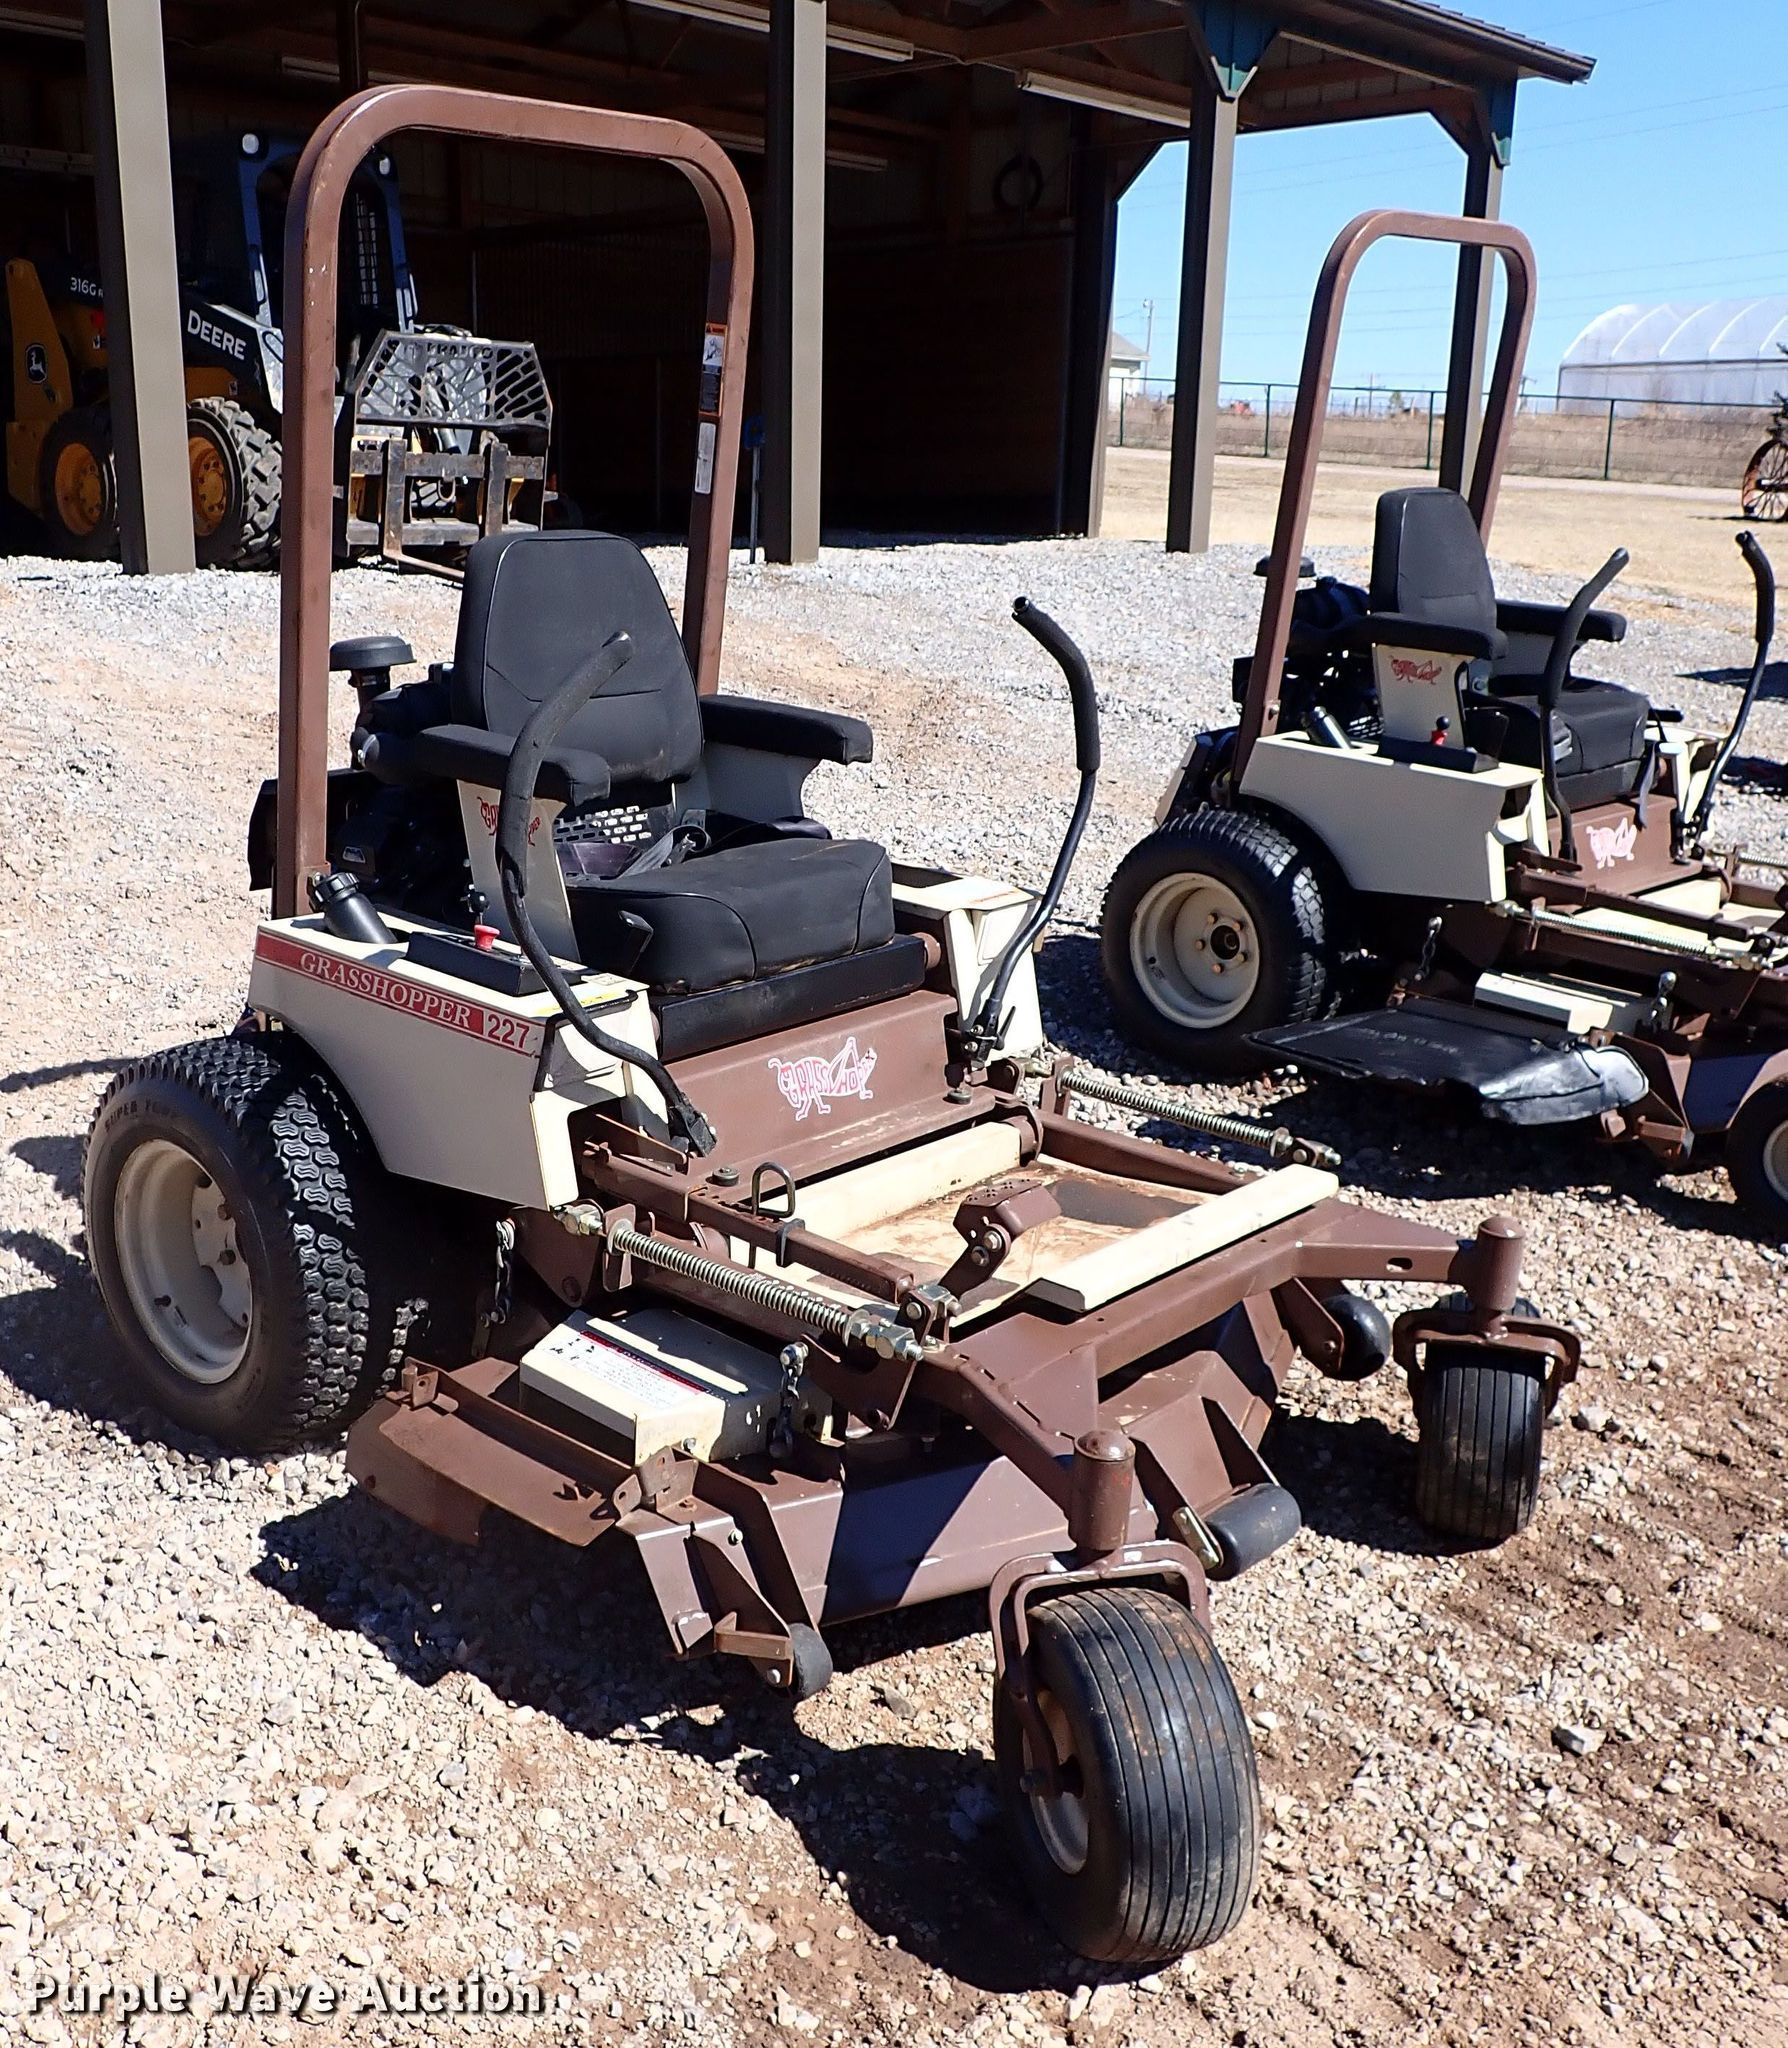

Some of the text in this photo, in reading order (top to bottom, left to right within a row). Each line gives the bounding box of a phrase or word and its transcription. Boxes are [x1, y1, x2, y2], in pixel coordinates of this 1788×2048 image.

[187, 309, 247, 361] DEERE
[299, 952, 530, 1049] GRASSHOPPER 227
